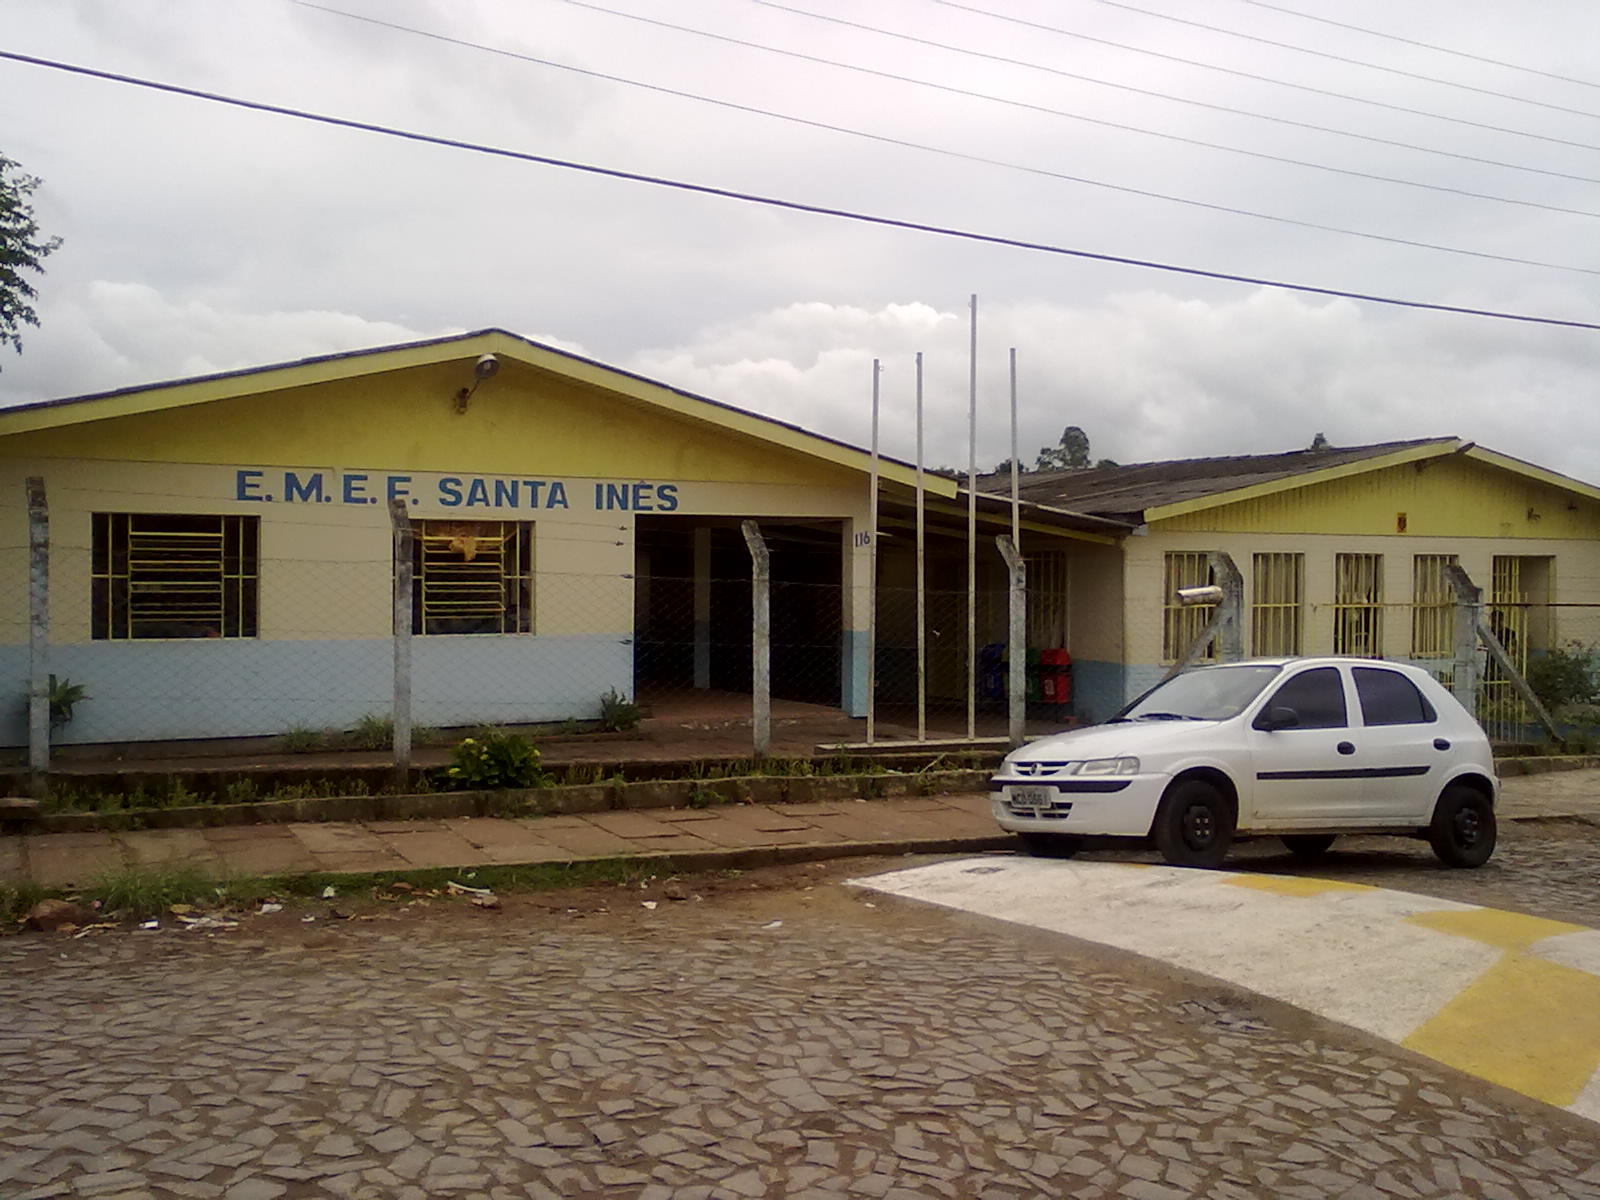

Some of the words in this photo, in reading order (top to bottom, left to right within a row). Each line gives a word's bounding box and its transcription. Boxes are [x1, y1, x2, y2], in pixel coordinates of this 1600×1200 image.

[438, 477, 570, 510] SANTA
[595, 480, 679, 512] INÊS
[855, 531, 871, 548] 116
